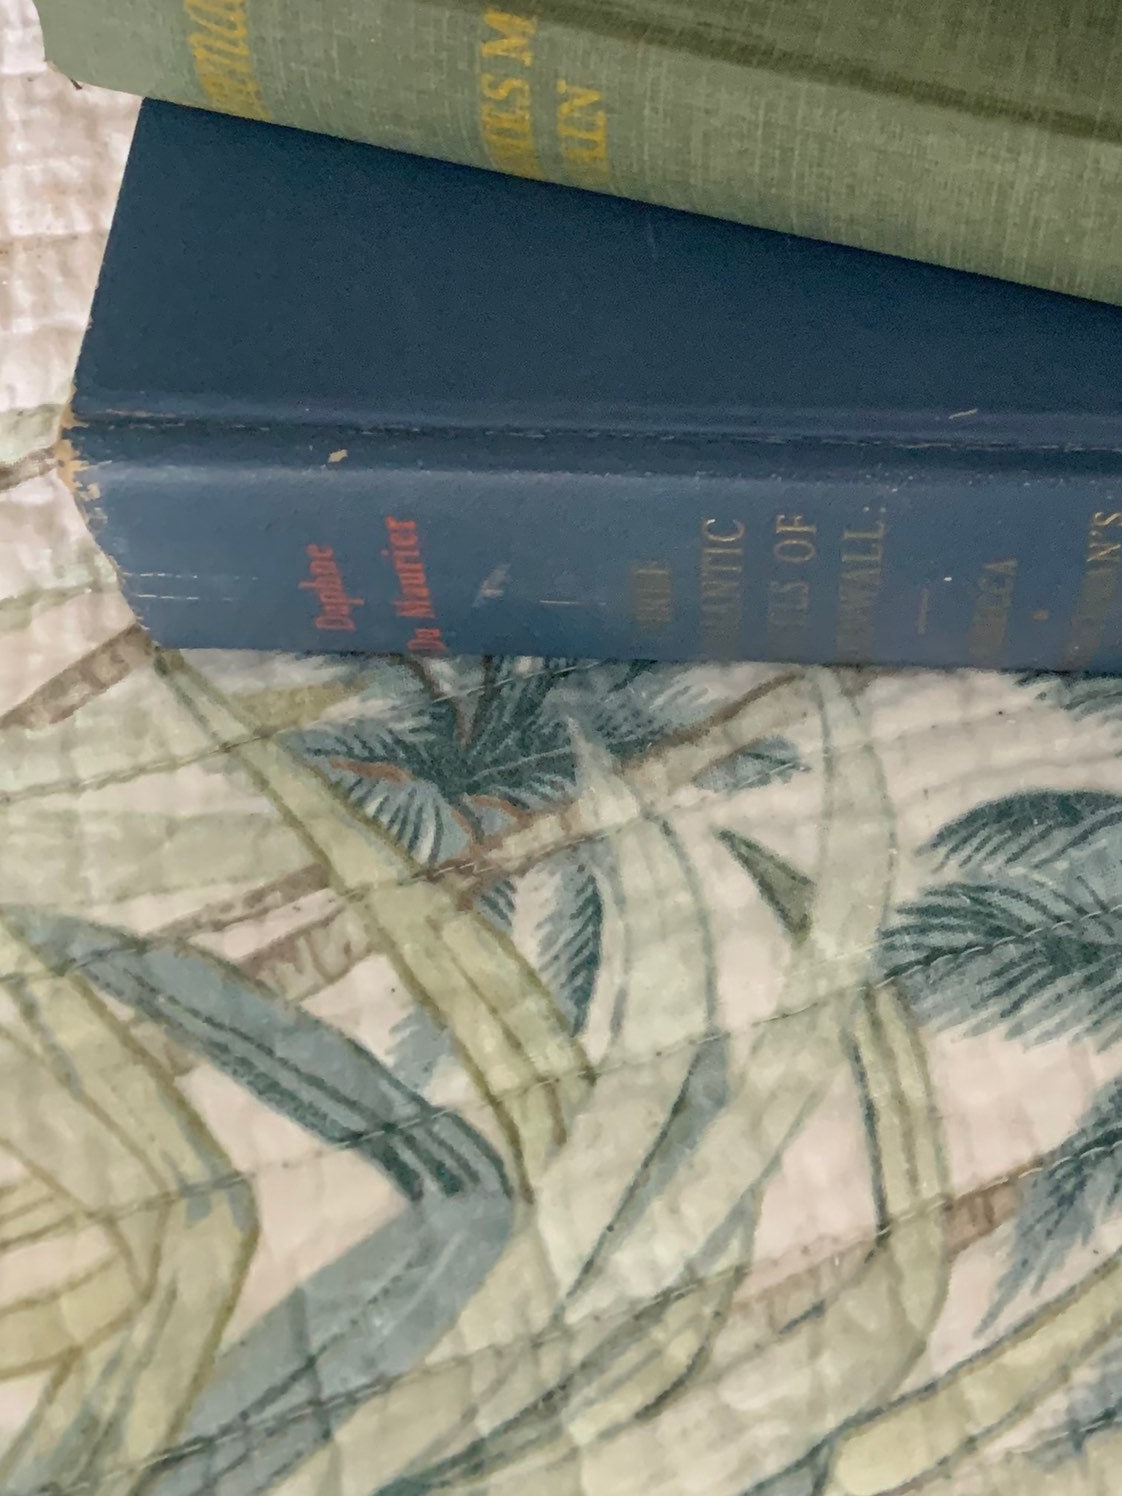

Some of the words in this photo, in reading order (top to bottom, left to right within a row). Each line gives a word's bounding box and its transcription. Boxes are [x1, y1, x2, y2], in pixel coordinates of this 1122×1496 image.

[382, 514, 436, 619] Maurier
[773, 513, 817, 564] OF
[298, 543, 365, 631] Daphne
[407, 628, 447, 651] Du
